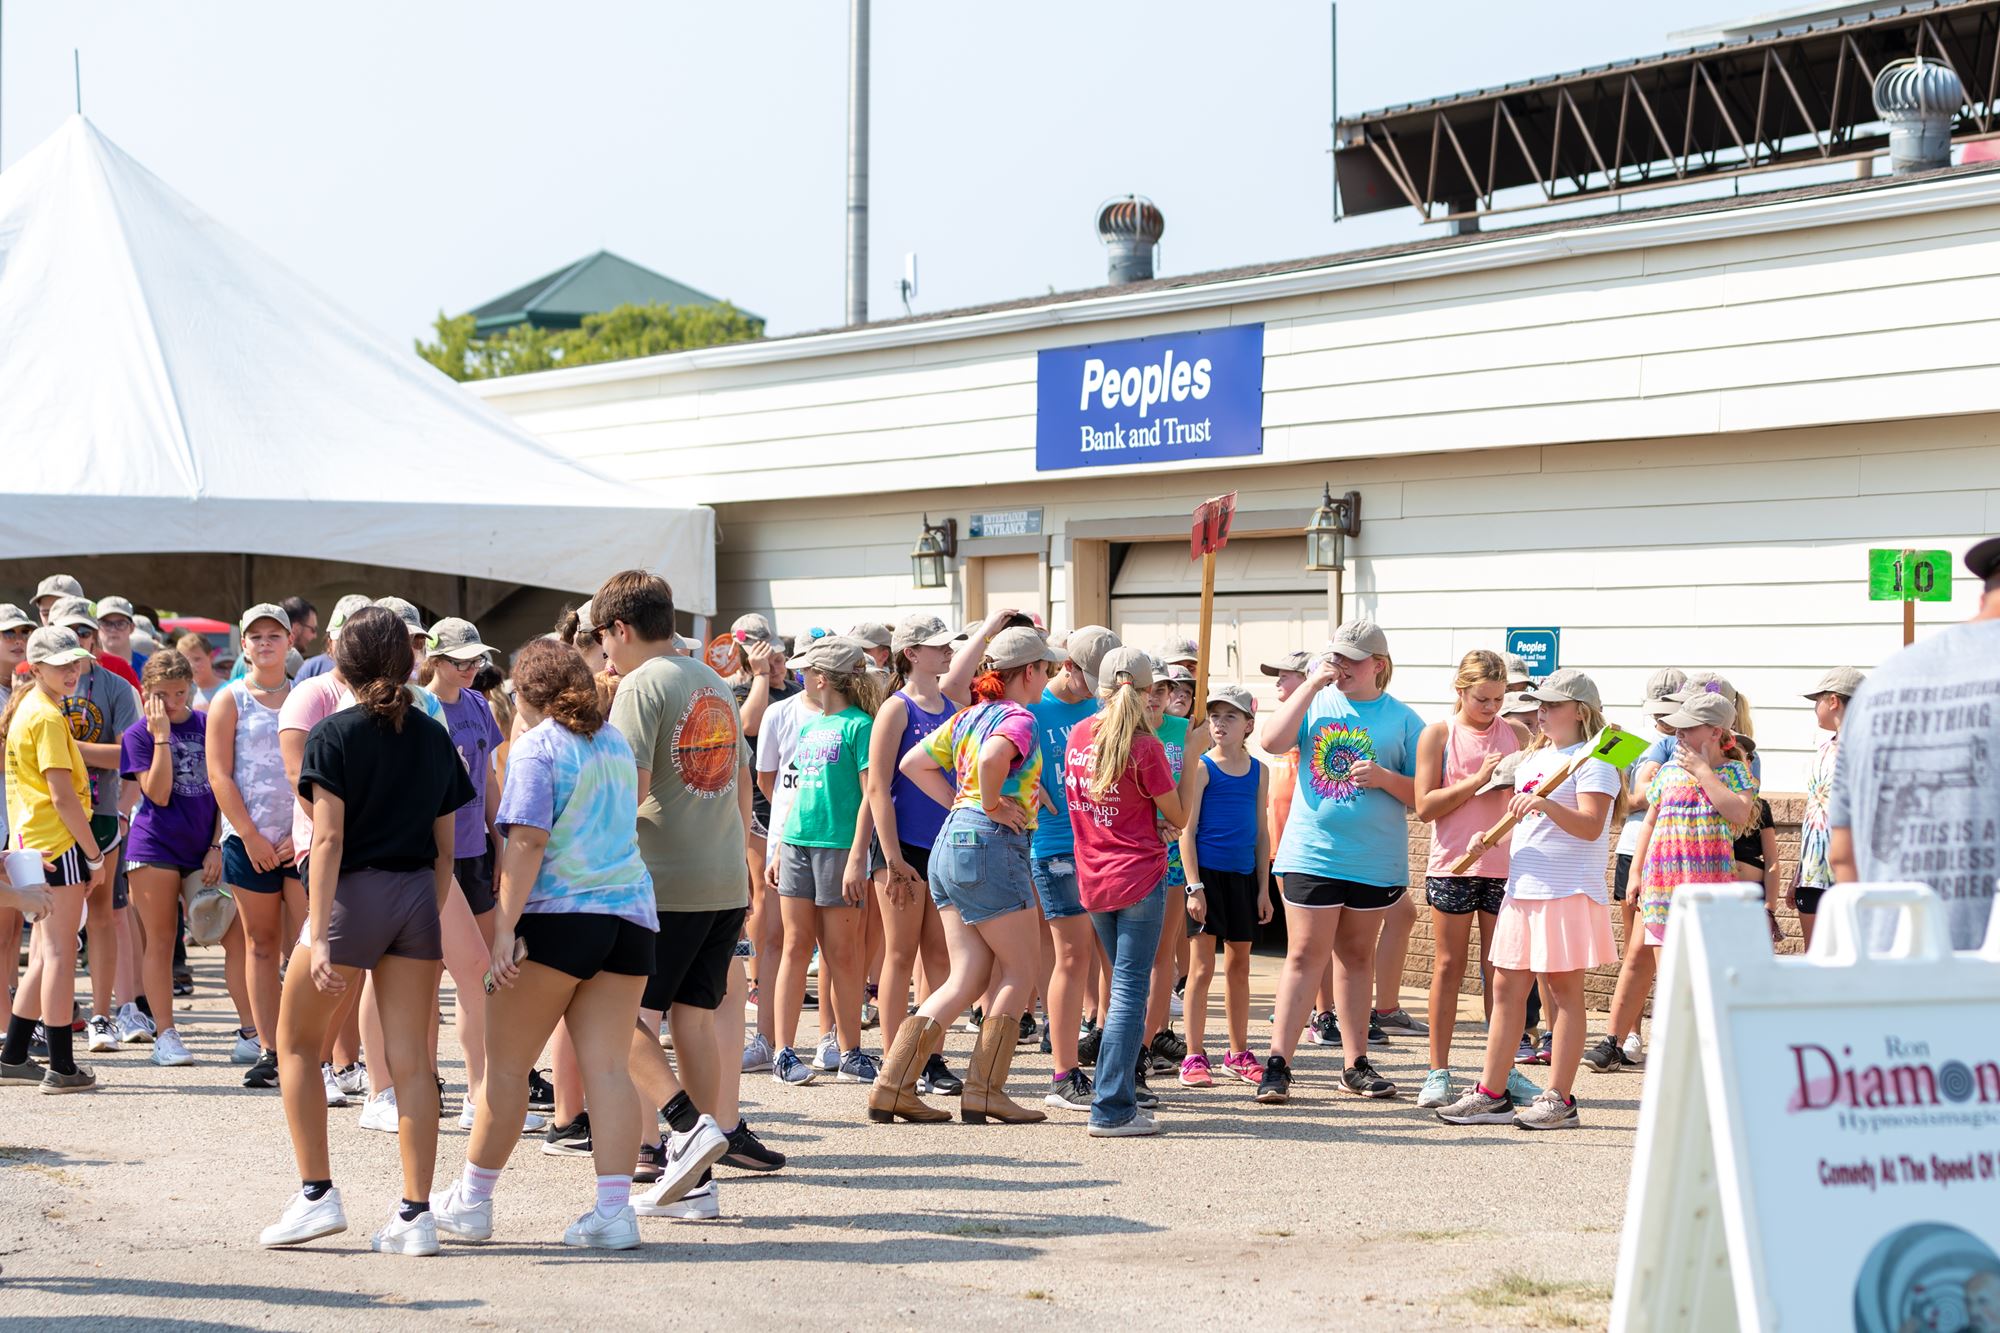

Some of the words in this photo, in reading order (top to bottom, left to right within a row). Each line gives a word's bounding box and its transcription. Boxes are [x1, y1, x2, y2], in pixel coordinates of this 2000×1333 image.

[1080, 350, 1212, 417] Peoples
[1080, 422, 1127, 452] Bank
[1129, 418, 1161, 448] and
[1163, 417, 1211, 444] Trust
[983, 521, 1026, 536] ENTRANCE
[1893, 560, 1934, 592] 10
[1517, 640, 1547, 654] Peoples
[1872, 702, 1990, 736] EVERYTHING
[671, 725, 684, 774] LATITUDE
[1909, 822, 1949, 845] THIS
[1955, 819, 1973, 842] IS
[1983, 818, 1995, 841] A
[1900, 847, 1995, 874] CORDLESS
[1885, 1035, 1930, 1059] Ron
[1819, 1157, 1876, 1193] Comedy
[1881, 1154, 1897, 1183] At
[1900, 1154, 1927, 1182] The
[1931, 1153, 1974, 1189] Speed
[1978, 1151, 1993, 1178] Of
